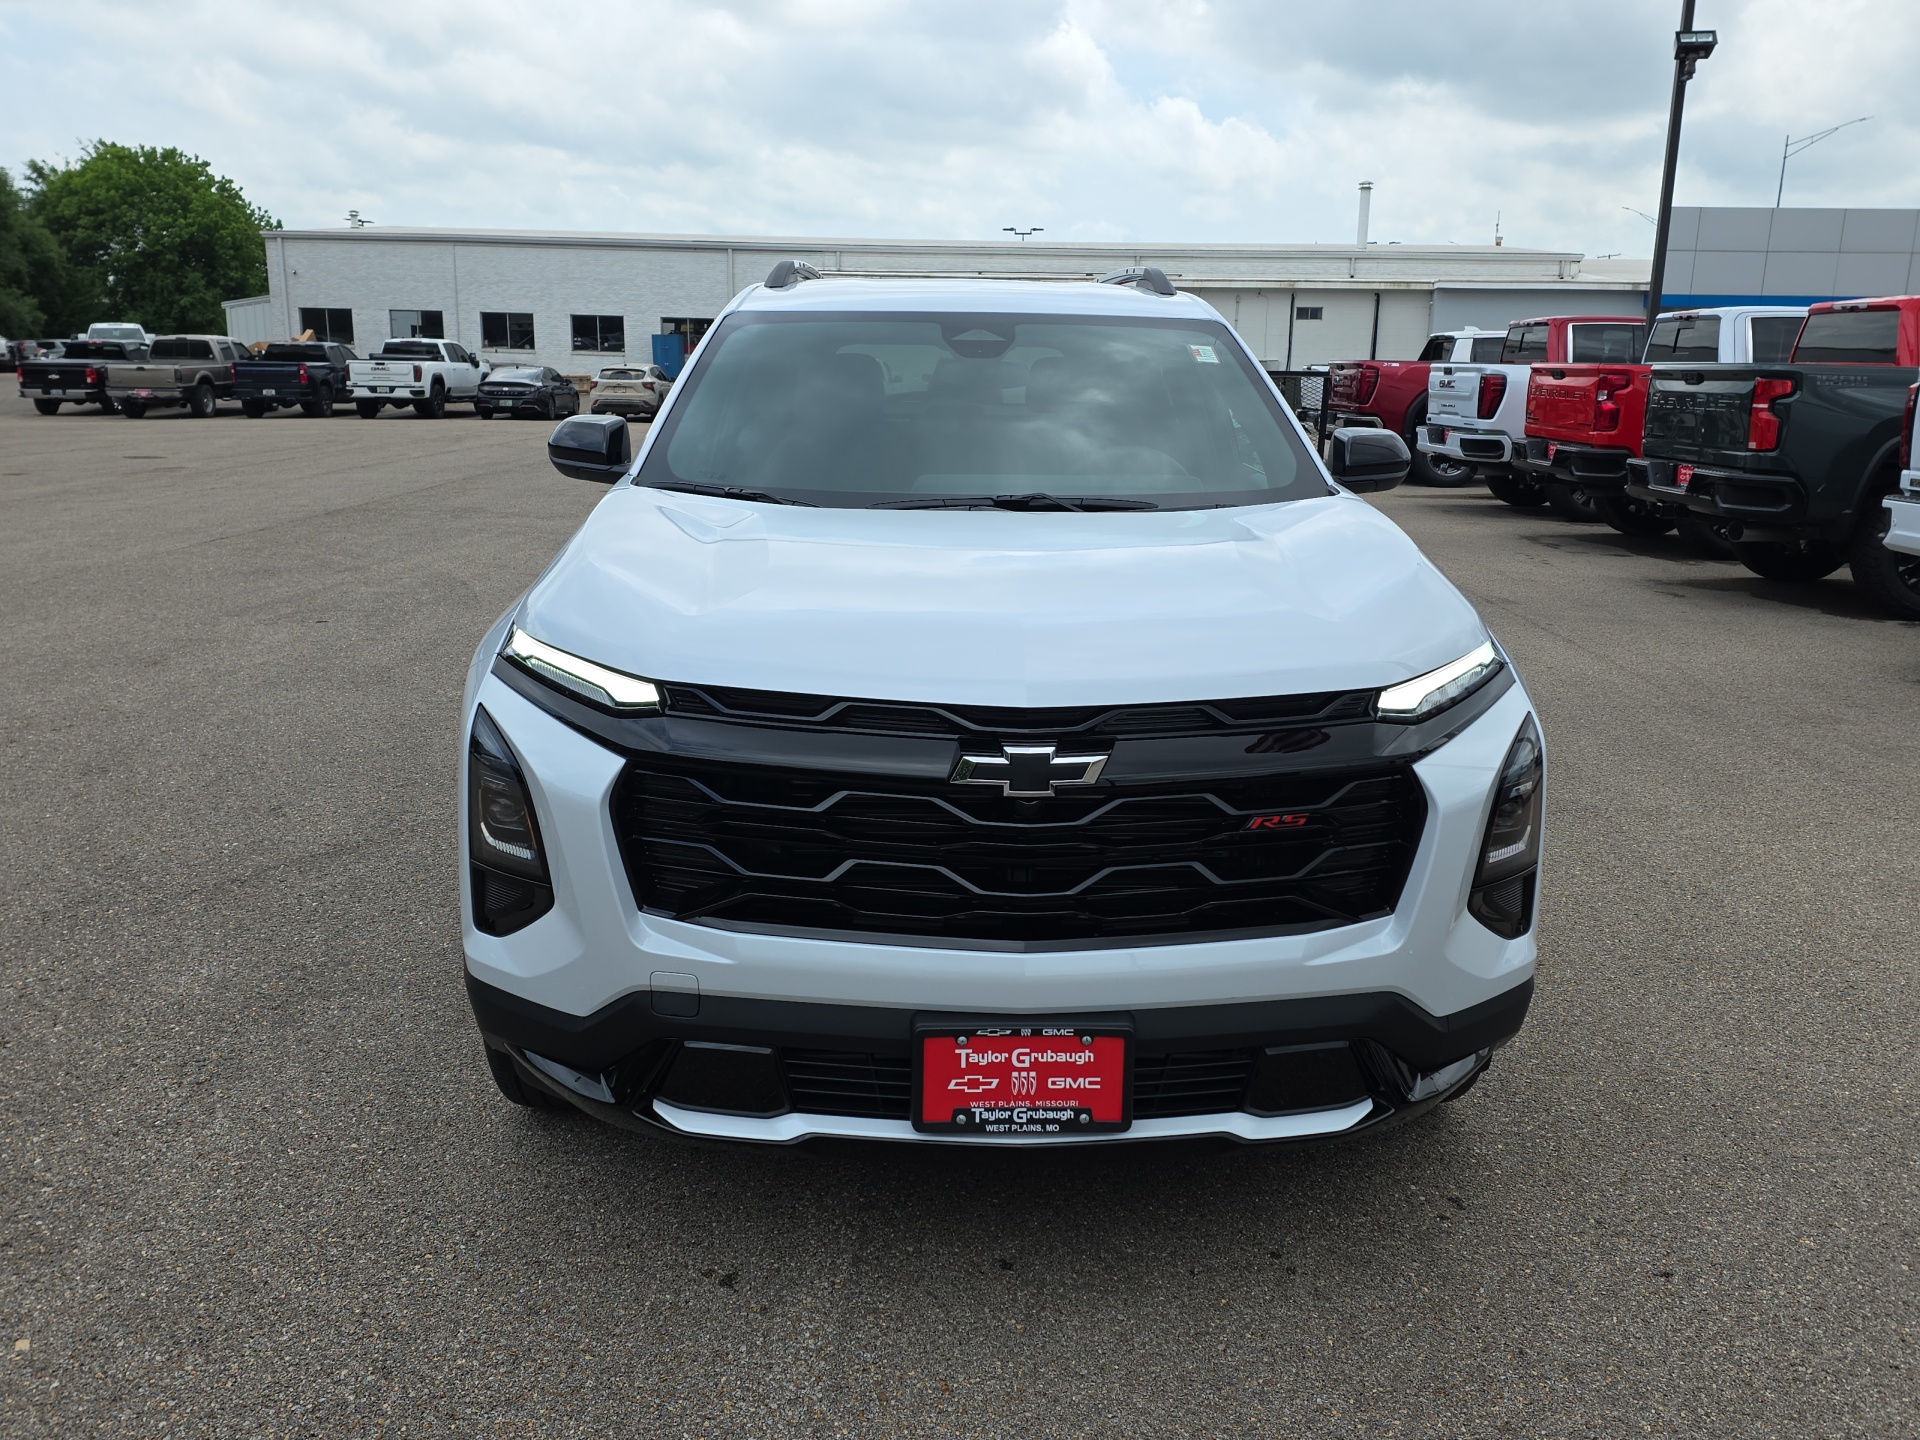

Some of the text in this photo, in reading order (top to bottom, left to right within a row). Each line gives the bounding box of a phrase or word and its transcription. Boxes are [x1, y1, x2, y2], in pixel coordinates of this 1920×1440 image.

[1246, 813, 1311, 829] RS
[954, 1048, 1094, 1069] Taylor Grubaugh
[1047, 1077, 1101, 1089] GMC
[971, 1108, 1074, 1123] Taylor Grubaugh
[986, 1124, 1060, 1133] WEST PLAINS, MO
